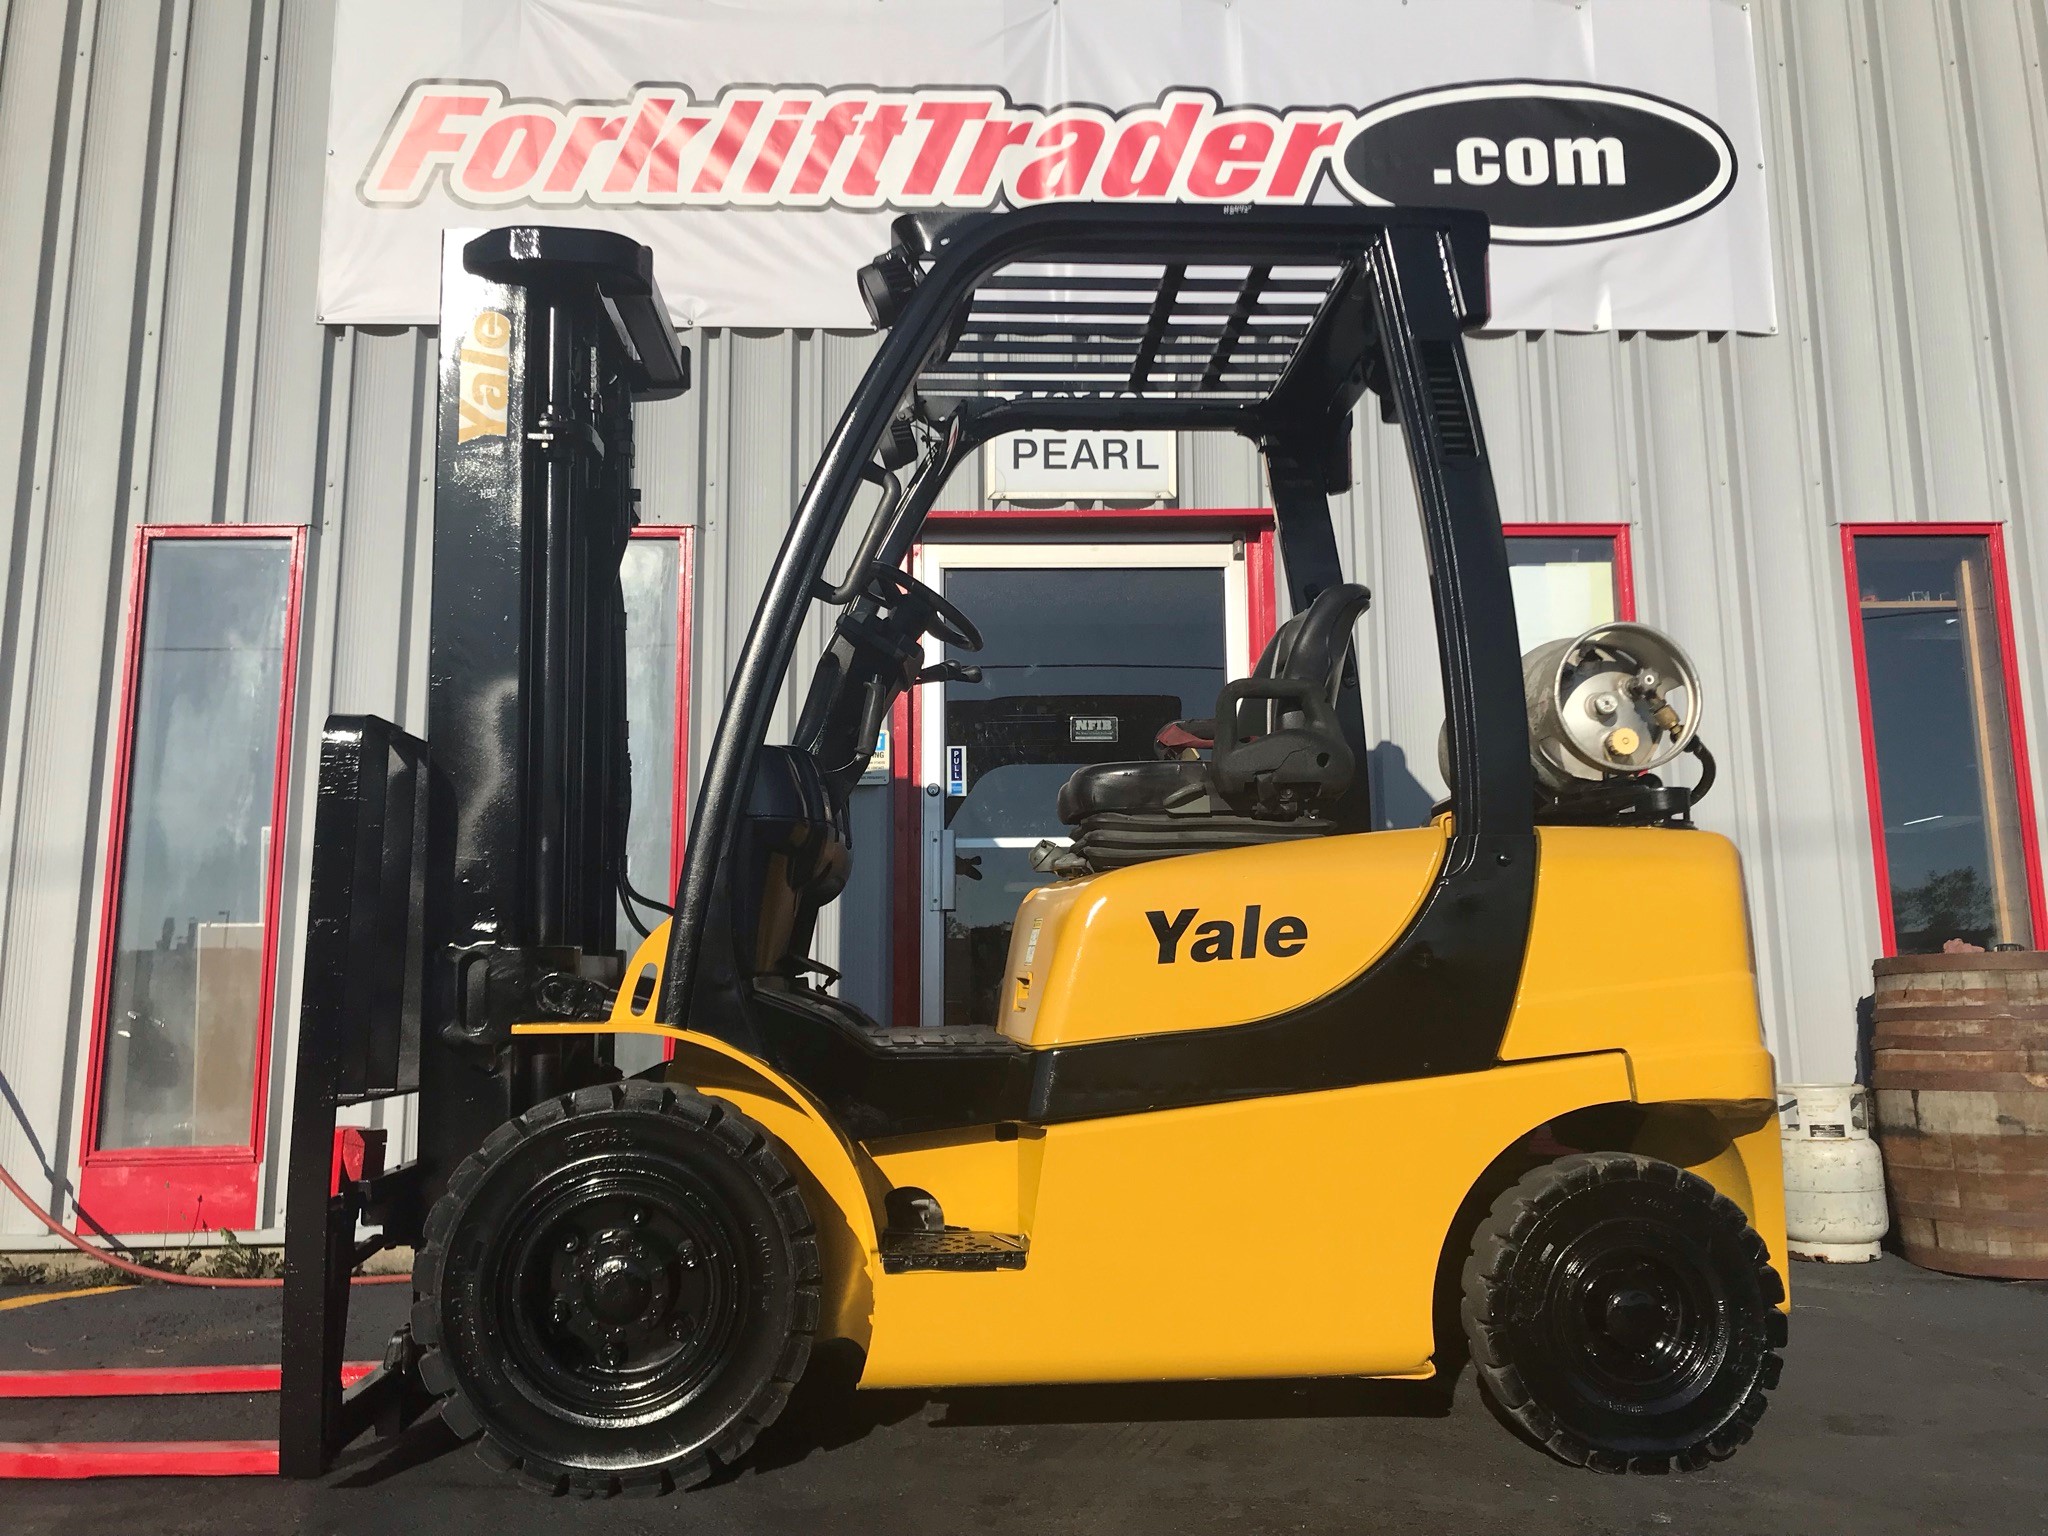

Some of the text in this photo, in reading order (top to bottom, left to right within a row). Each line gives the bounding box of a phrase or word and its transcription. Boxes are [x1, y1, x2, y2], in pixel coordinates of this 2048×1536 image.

[458, 311, 511, 445] Yale
[1013, 438, 1159, 470] PEARL
[1145, 905, 1308, 965] Yale
